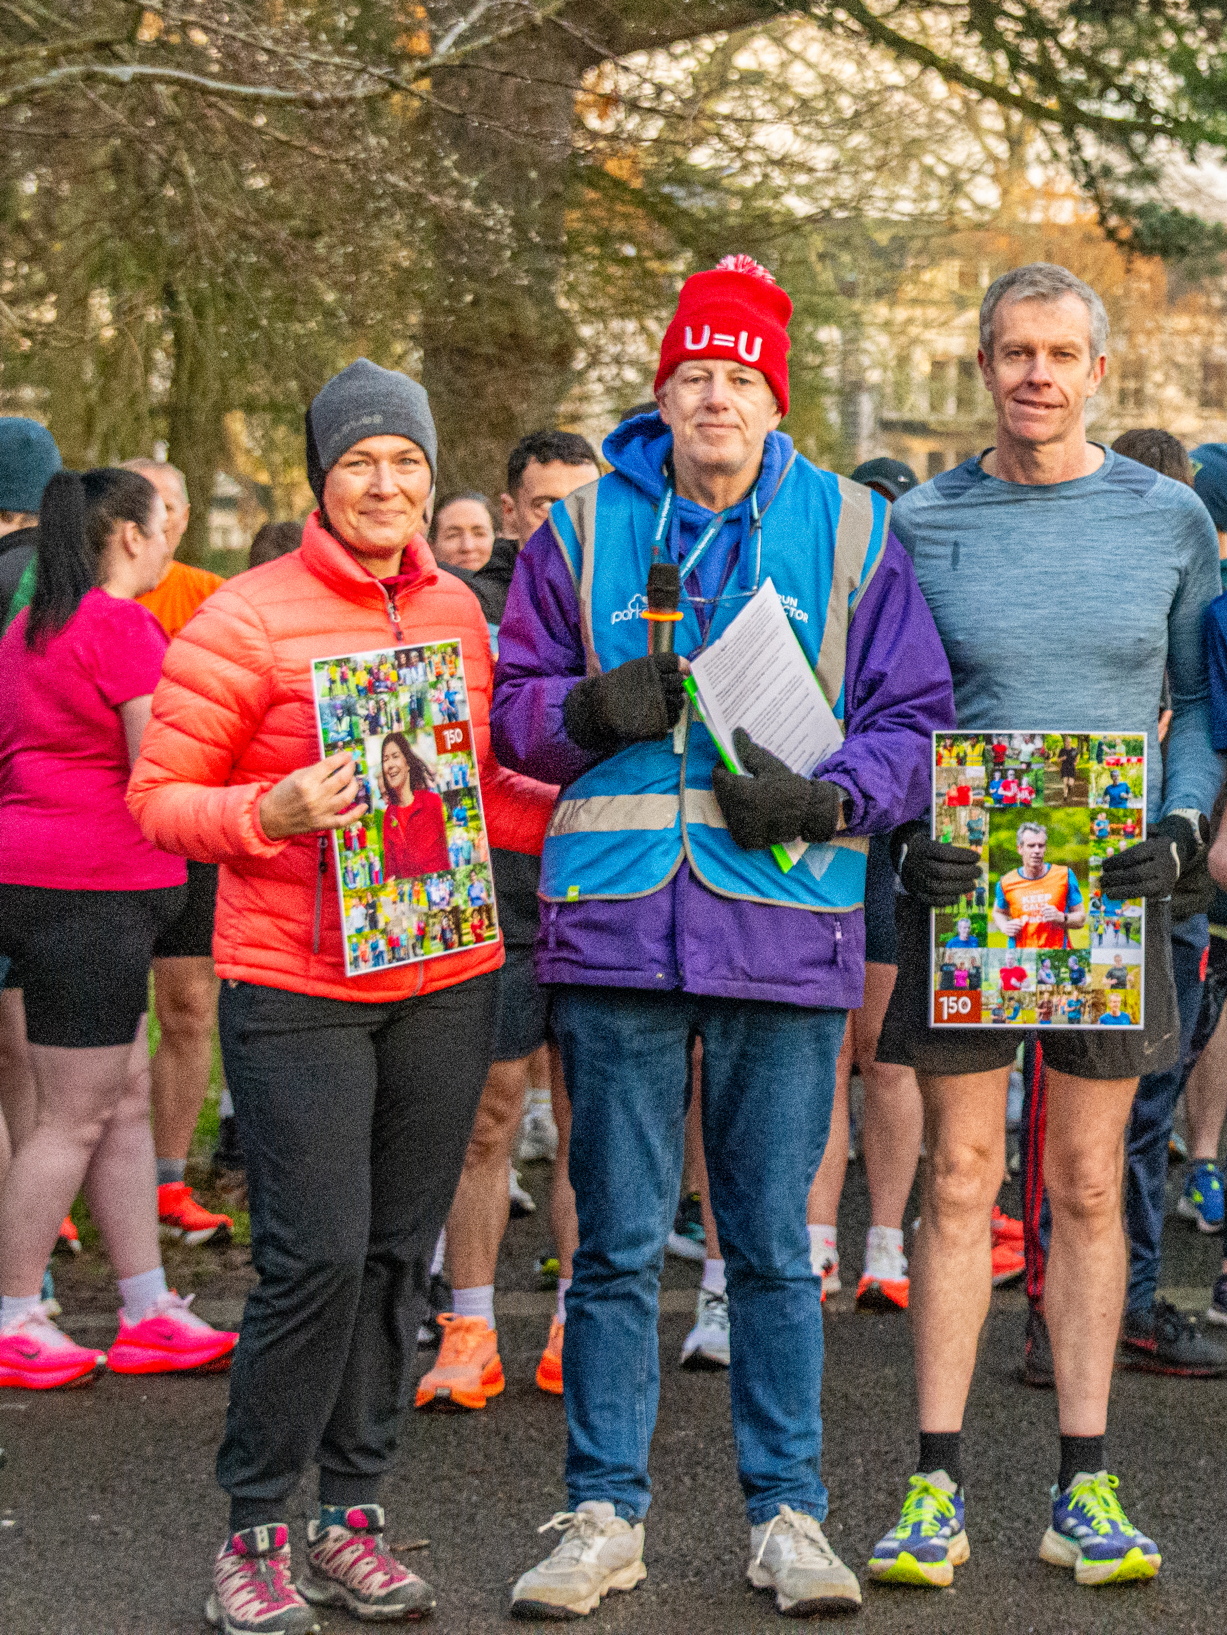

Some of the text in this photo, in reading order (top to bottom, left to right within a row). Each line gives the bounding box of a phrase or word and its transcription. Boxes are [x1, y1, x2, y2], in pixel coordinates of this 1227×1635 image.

[684, 325, 763, 362] U=U
[611, 603, 649, 625] park
[783, 605, 809, 623] CTOR
[442, 728, 463, 750] 150
[938, 996, 971, 1020] 150
